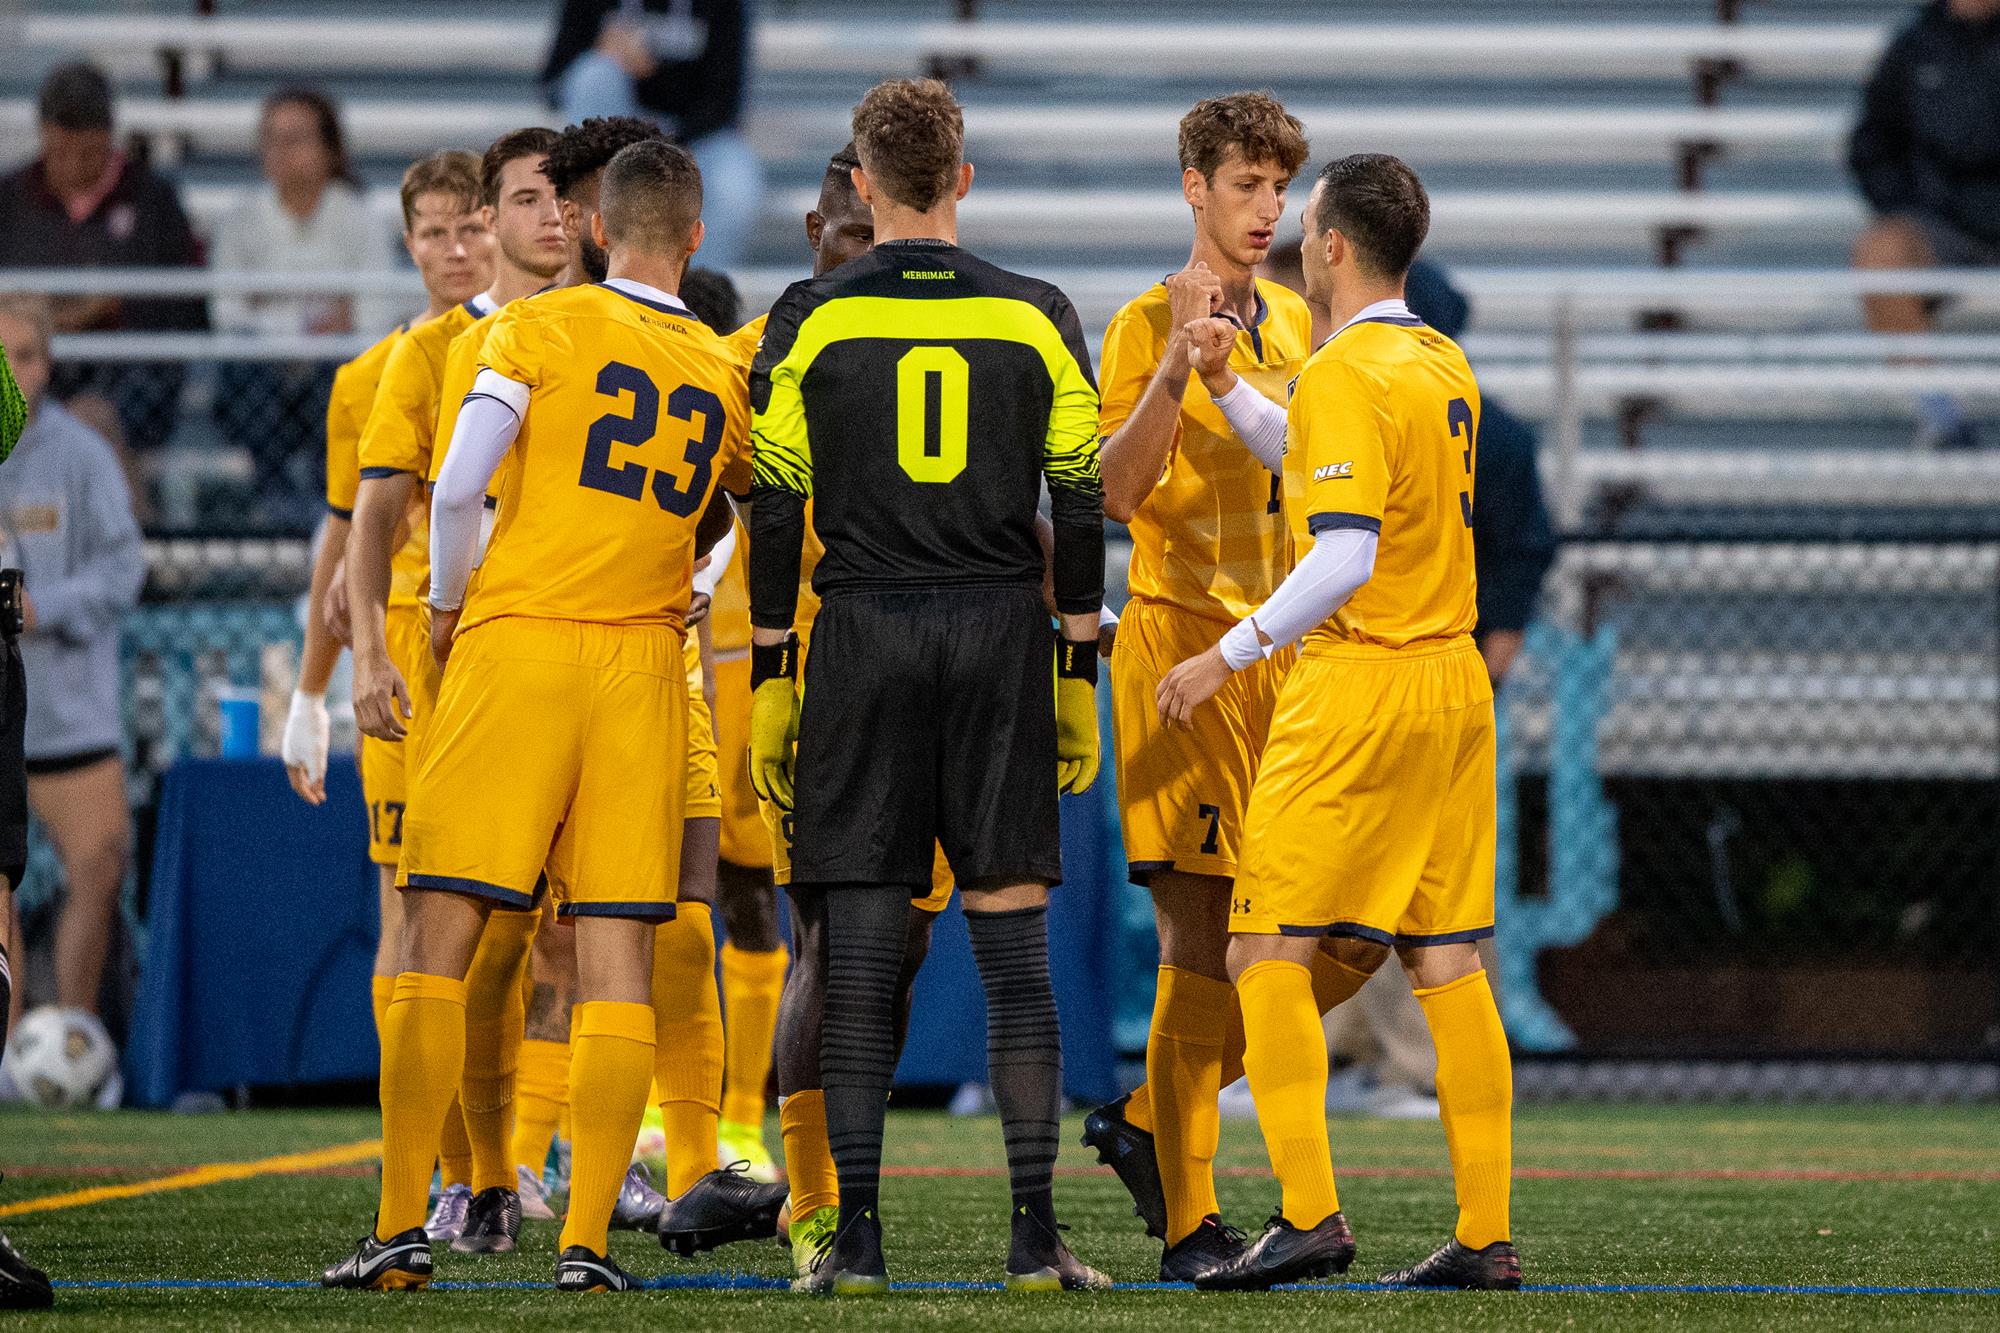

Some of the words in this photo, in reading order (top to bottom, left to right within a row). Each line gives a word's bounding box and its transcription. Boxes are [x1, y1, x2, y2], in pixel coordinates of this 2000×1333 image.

[902, 270, 956, 280] MERRIMACK
[897, 346, 969, 484] 0
[578, 360, 727, 519] 23
[1313, 460, 1354, 481] NEC
[1447, 397, 1474, 529] 3
[373, 801, 406, 845] 17
[1198, 803, 1220, 855] 7
[409, 1251, 432, 1265] NIKE
[560, 1271, 588, 1284] NIKE
